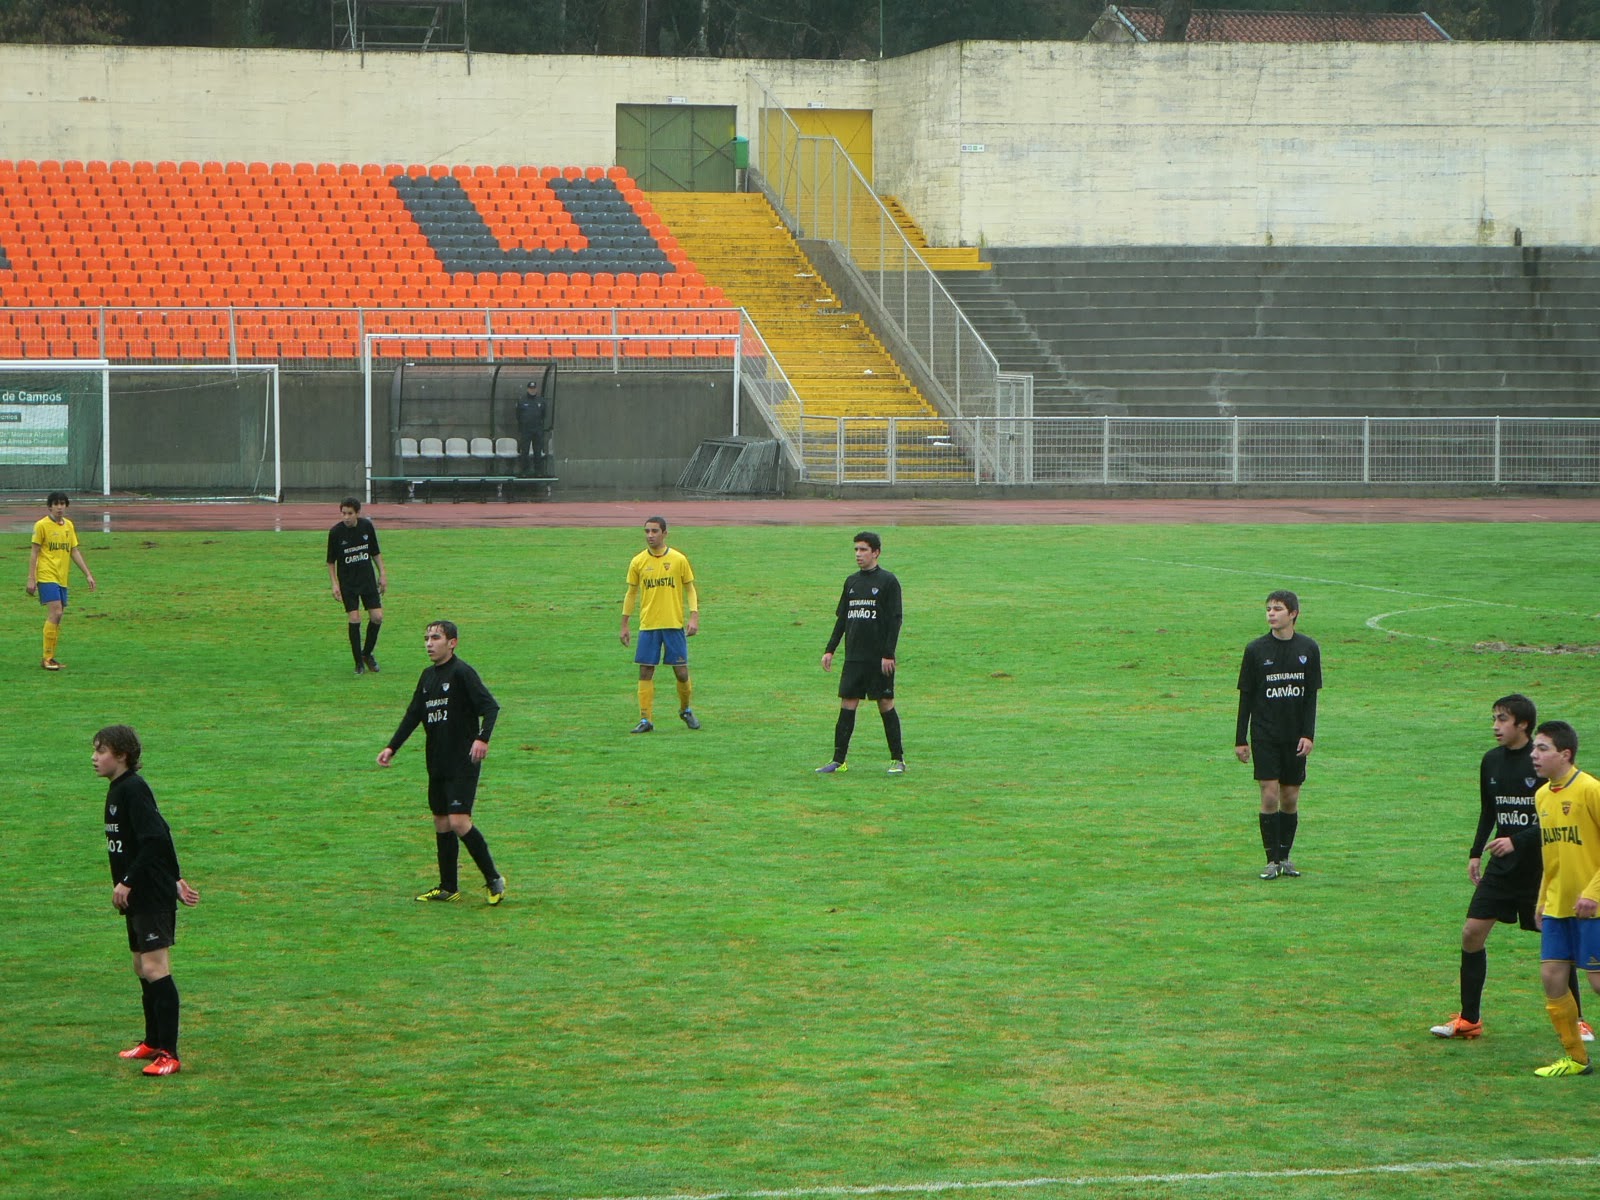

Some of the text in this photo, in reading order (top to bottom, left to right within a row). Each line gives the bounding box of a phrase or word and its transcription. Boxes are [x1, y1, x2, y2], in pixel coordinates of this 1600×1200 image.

[2, 390, 62, 404] de Campos
[871, 610, 877, 619] 2
[1266, 672, 1305, 681] RESTAURANTE
[1266, 684, 1300, 698] CARVÃO
[442, 710, 448, 721] 2
[1531, 813, 1539, 826] 2
